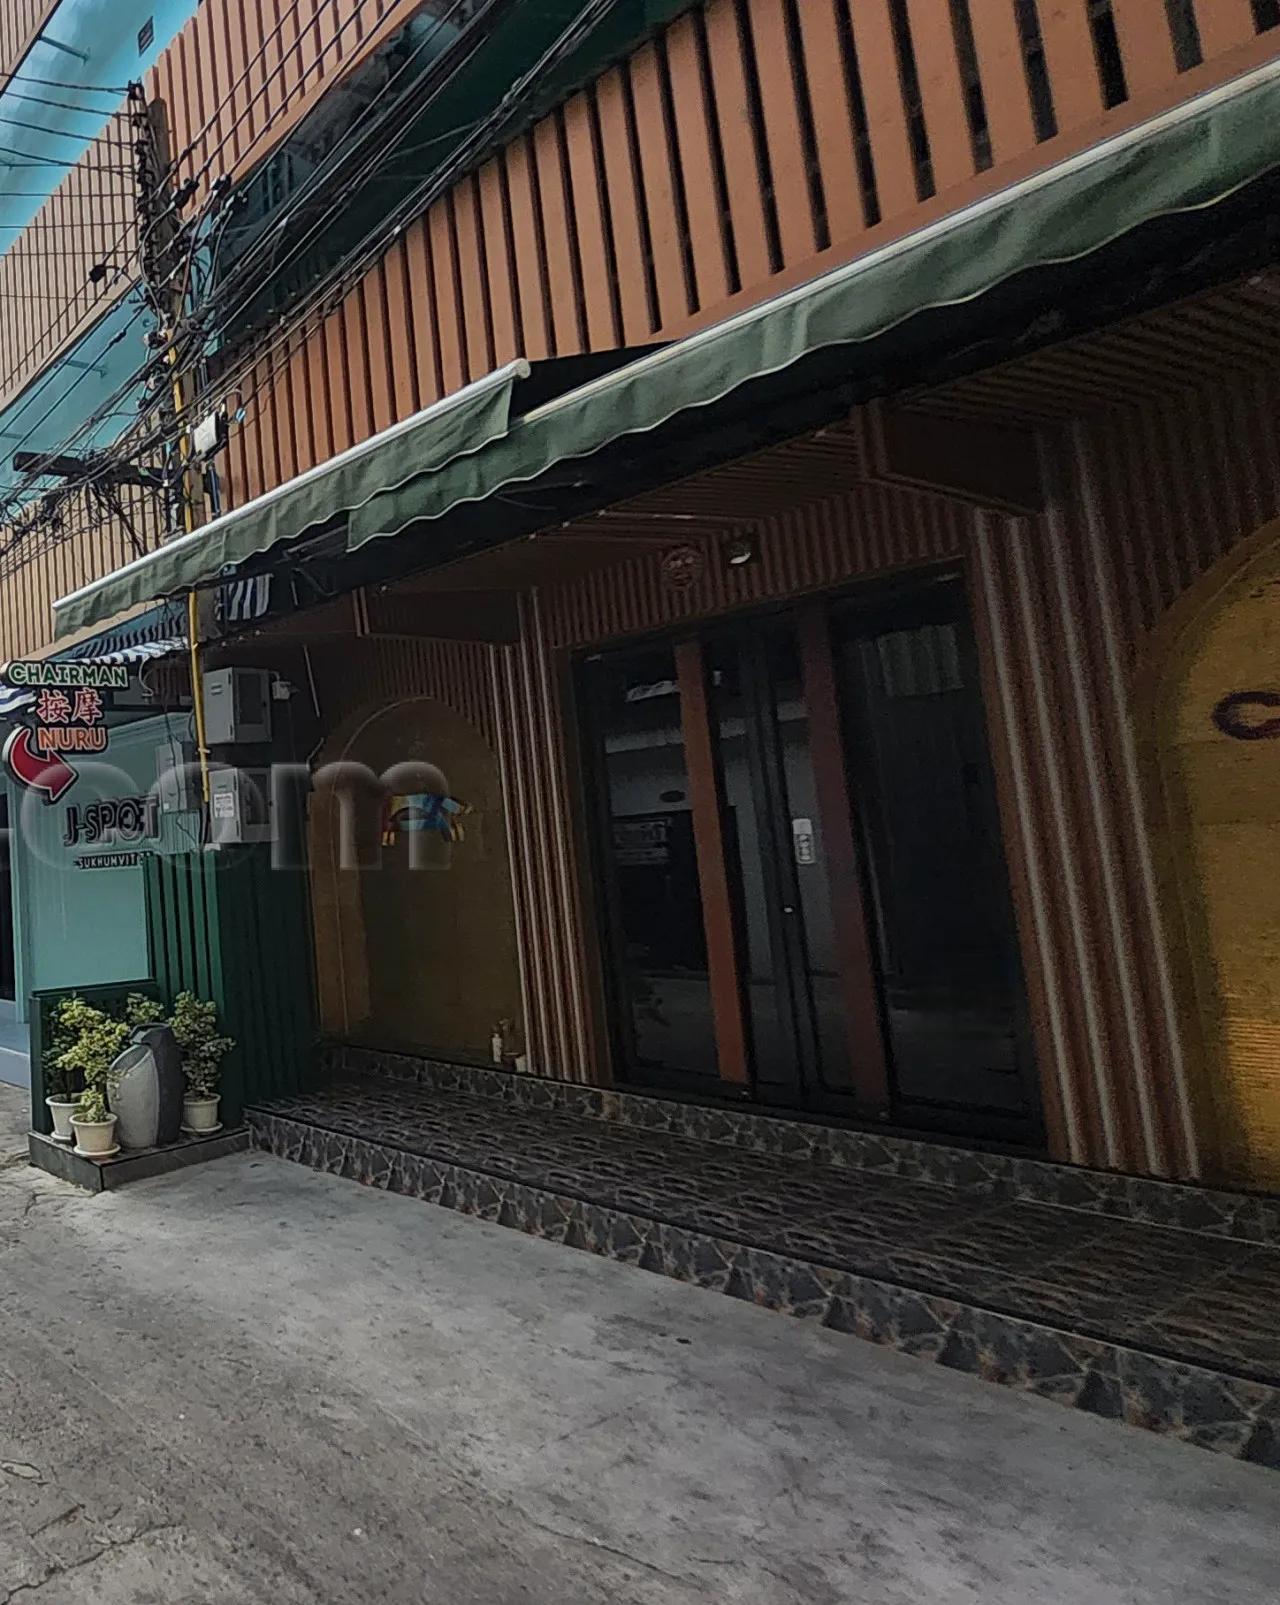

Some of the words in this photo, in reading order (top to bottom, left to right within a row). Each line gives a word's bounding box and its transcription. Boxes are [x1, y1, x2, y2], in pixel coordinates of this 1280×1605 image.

[8, 662, 129, 687] CHAIRMAN
[36, 687, 103, 725] 按摩
[37, 727, 106, 751] NURU
[63, 794, 160, 847] J-SPOT
